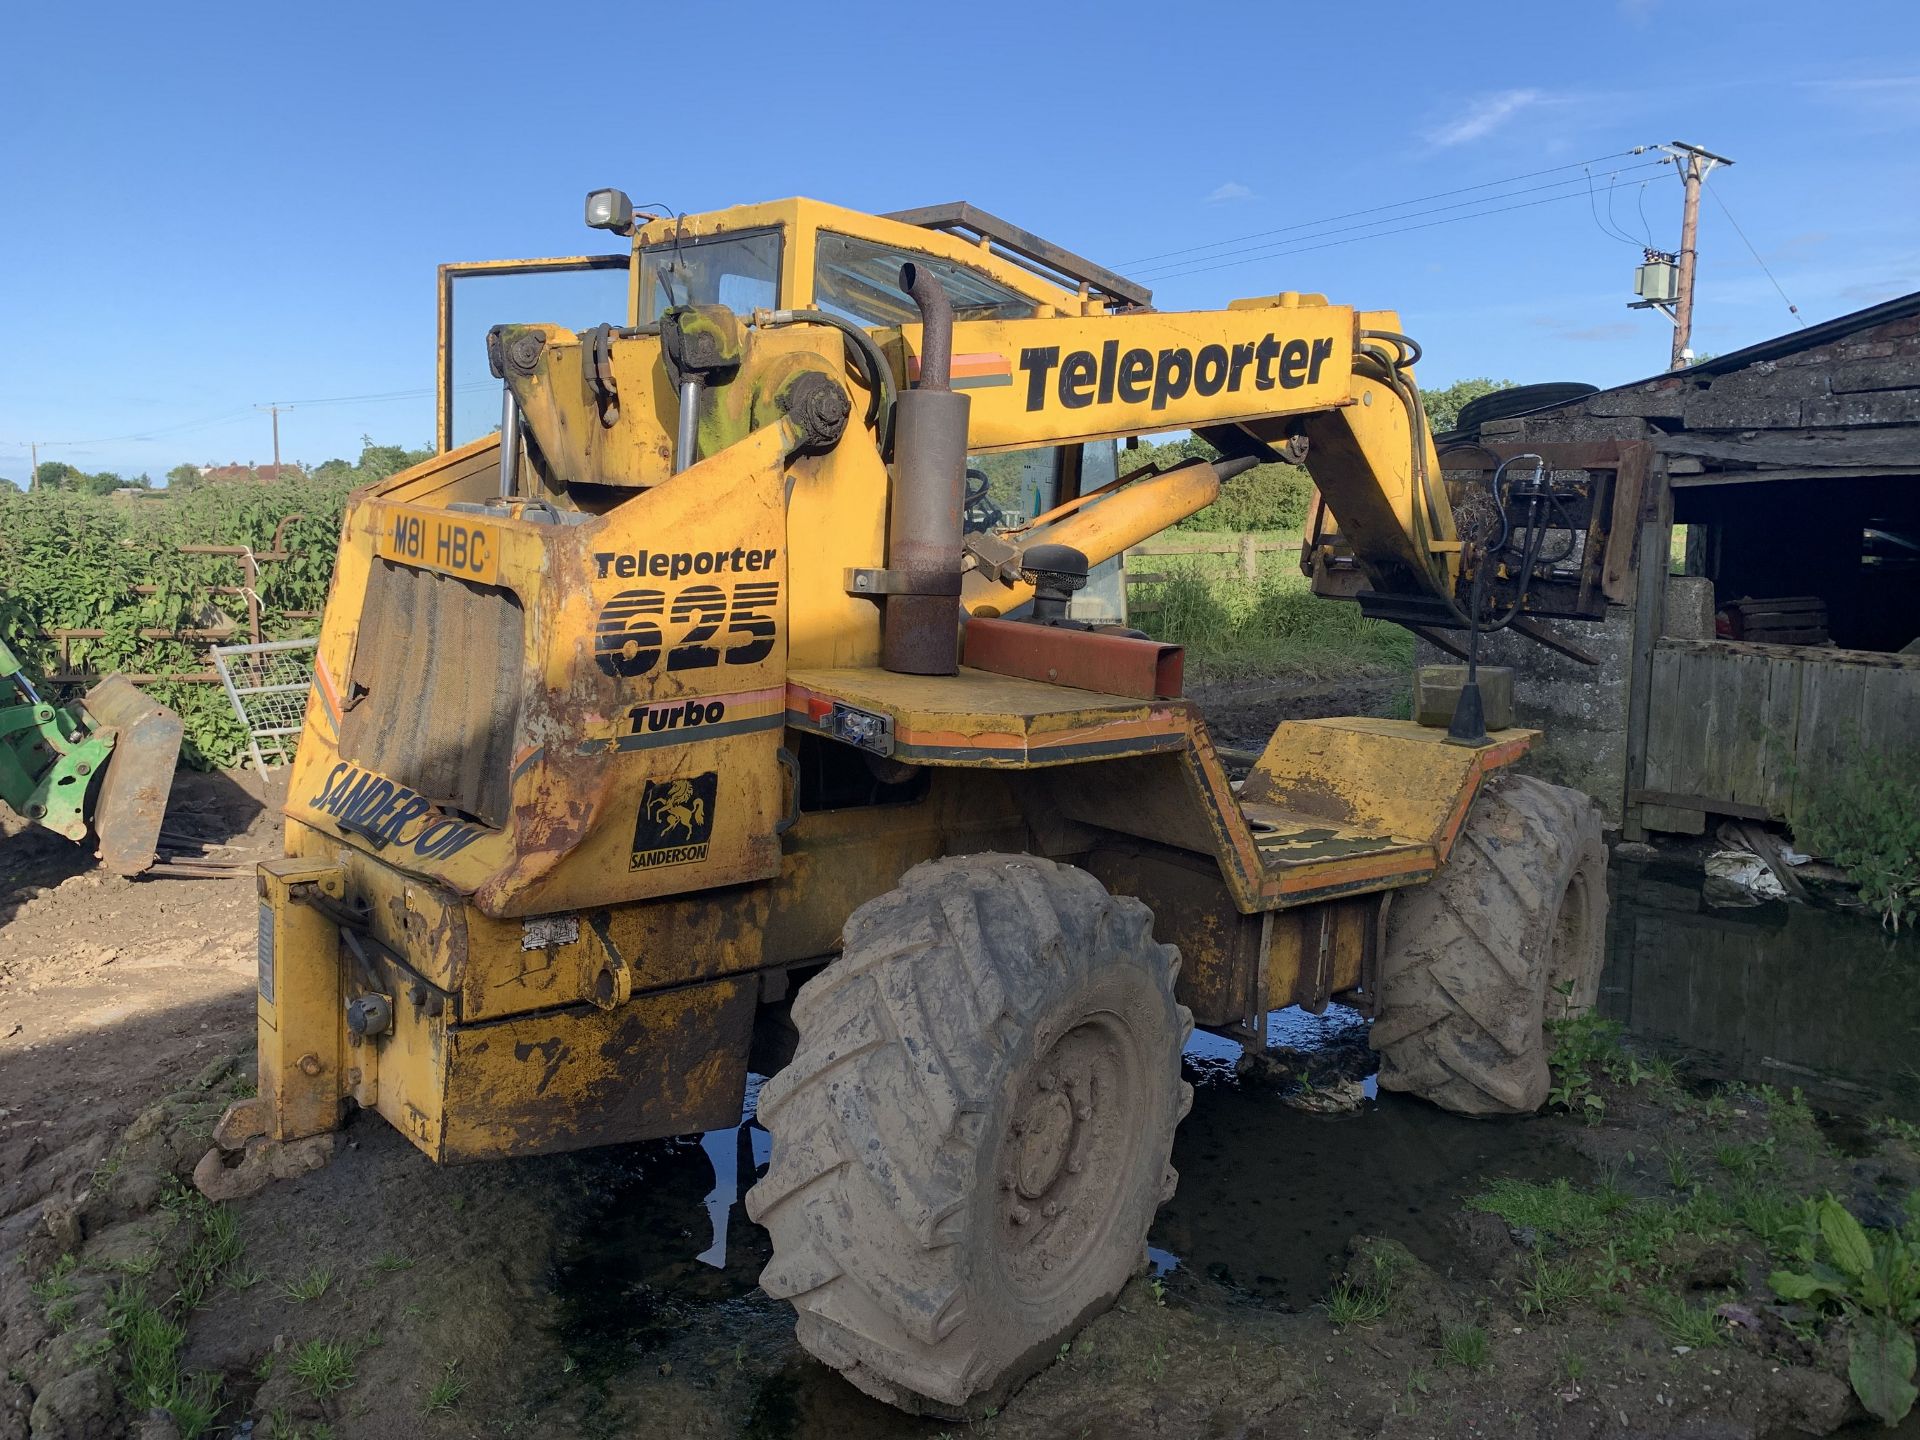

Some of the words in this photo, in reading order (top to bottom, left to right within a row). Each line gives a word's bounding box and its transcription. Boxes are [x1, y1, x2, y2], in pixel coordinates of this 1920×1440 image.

[1019, 333, 1334, 412] Teleporter
[393, 514, 426, 559] M81
[436, 522, 486, 573] HBC
[594, 547, 777, 581] Teleporter
[595, 582, 779, 678] 625
[628, 701, 725, 733] Turbo
[631, 845, 707, 869] SANDERSON
